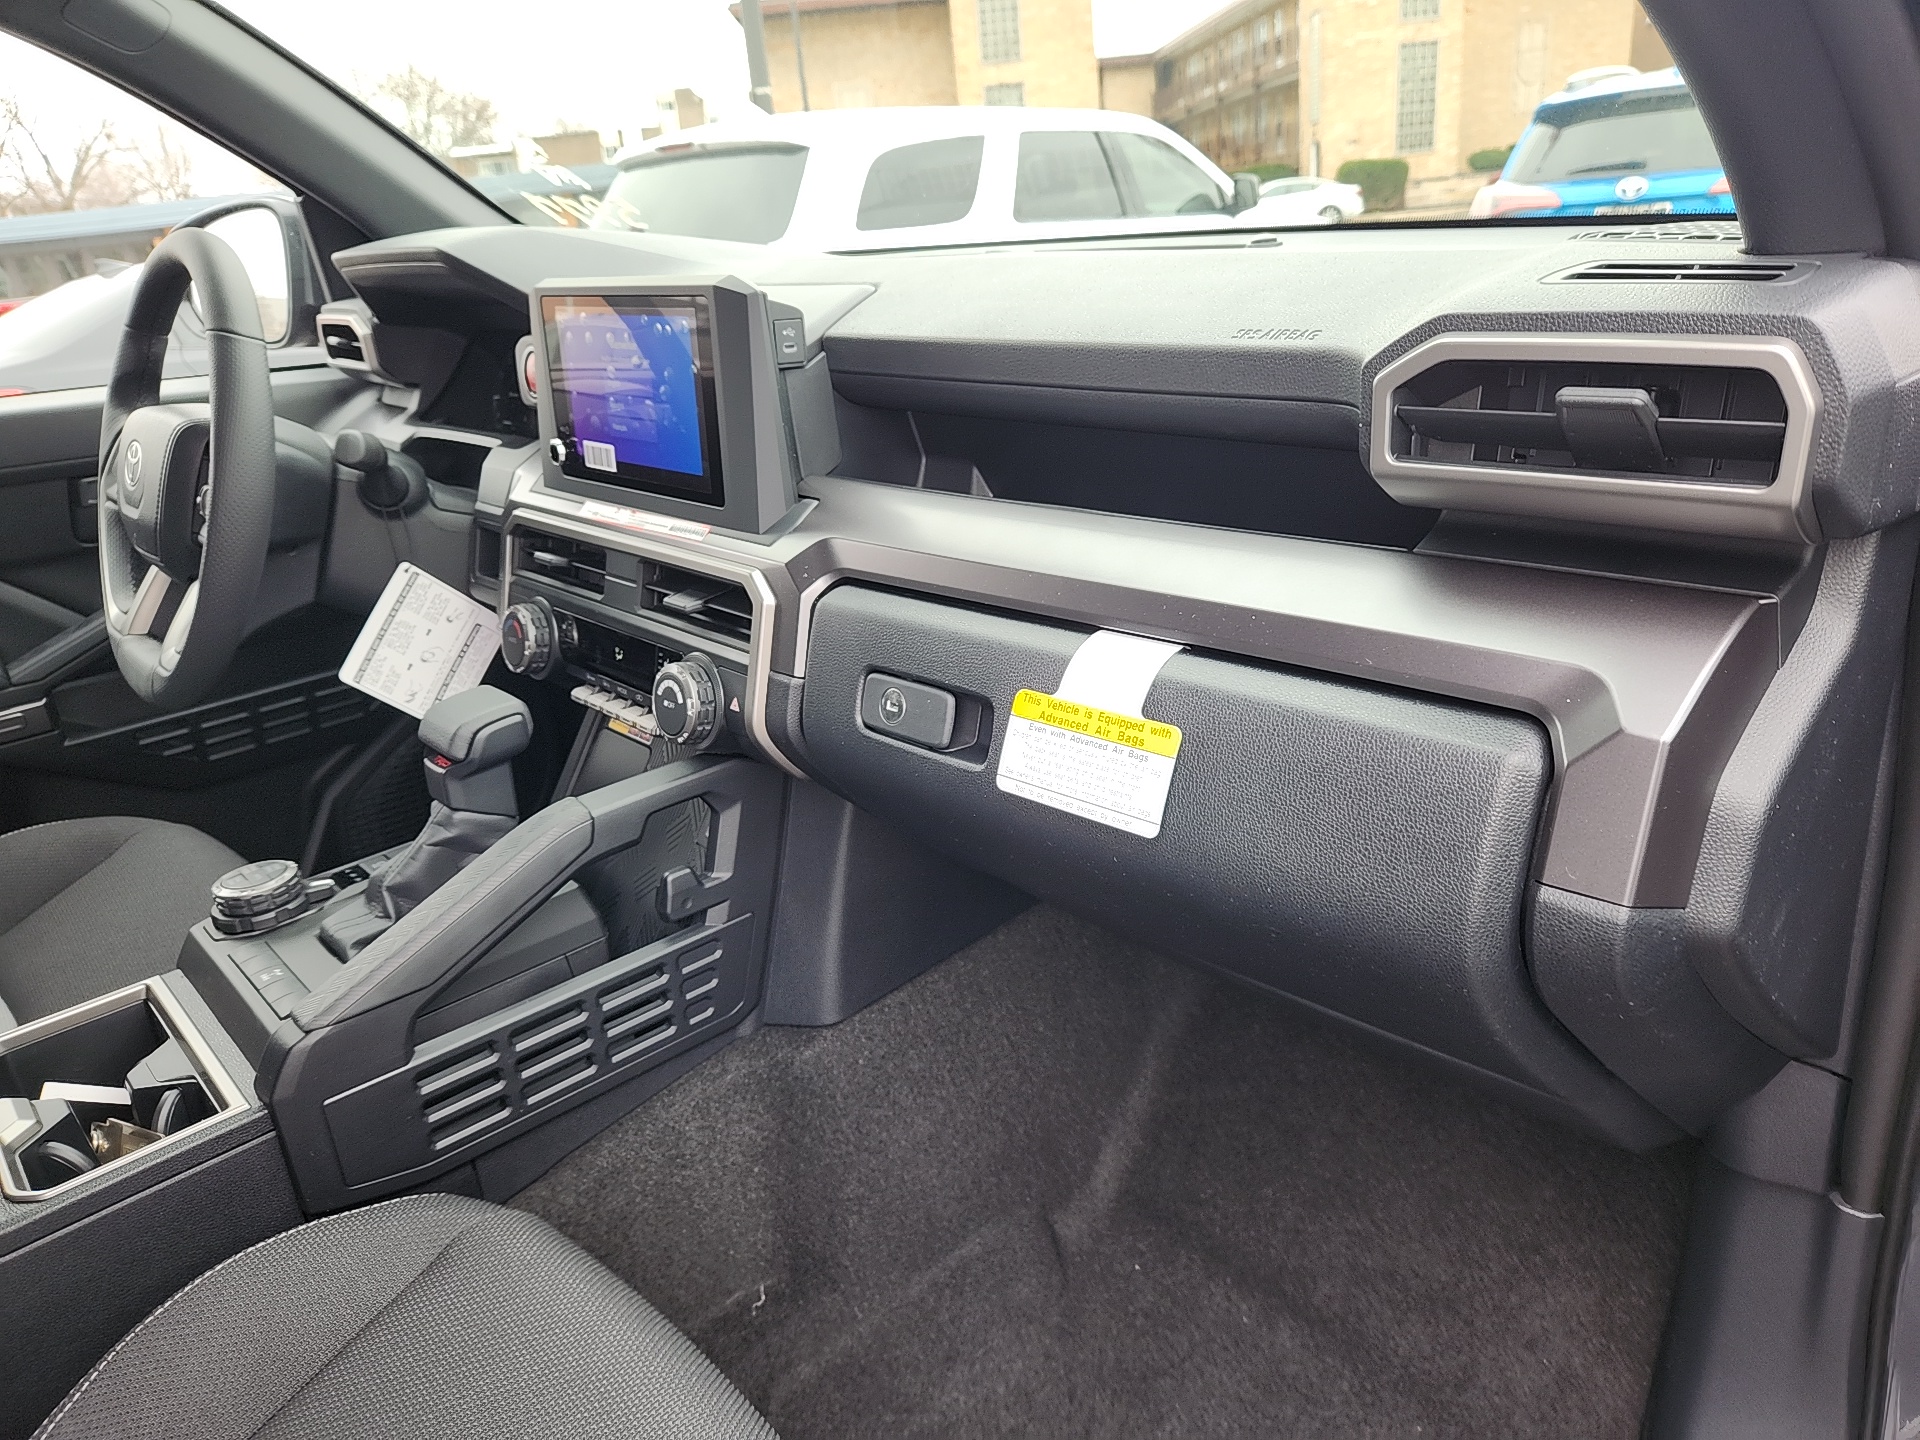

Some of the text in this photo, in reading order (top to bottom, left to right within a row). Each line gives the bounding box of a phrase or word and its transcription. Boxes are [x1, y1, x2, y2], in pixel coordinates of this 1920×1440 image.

[1023, 693, 1172, 739] This Vehicle is Equipped with
[1038, 711, 1145, 747] Advanced Air Bags
[1029, 723, 1149, 762] Even with Advanced Air Bags
